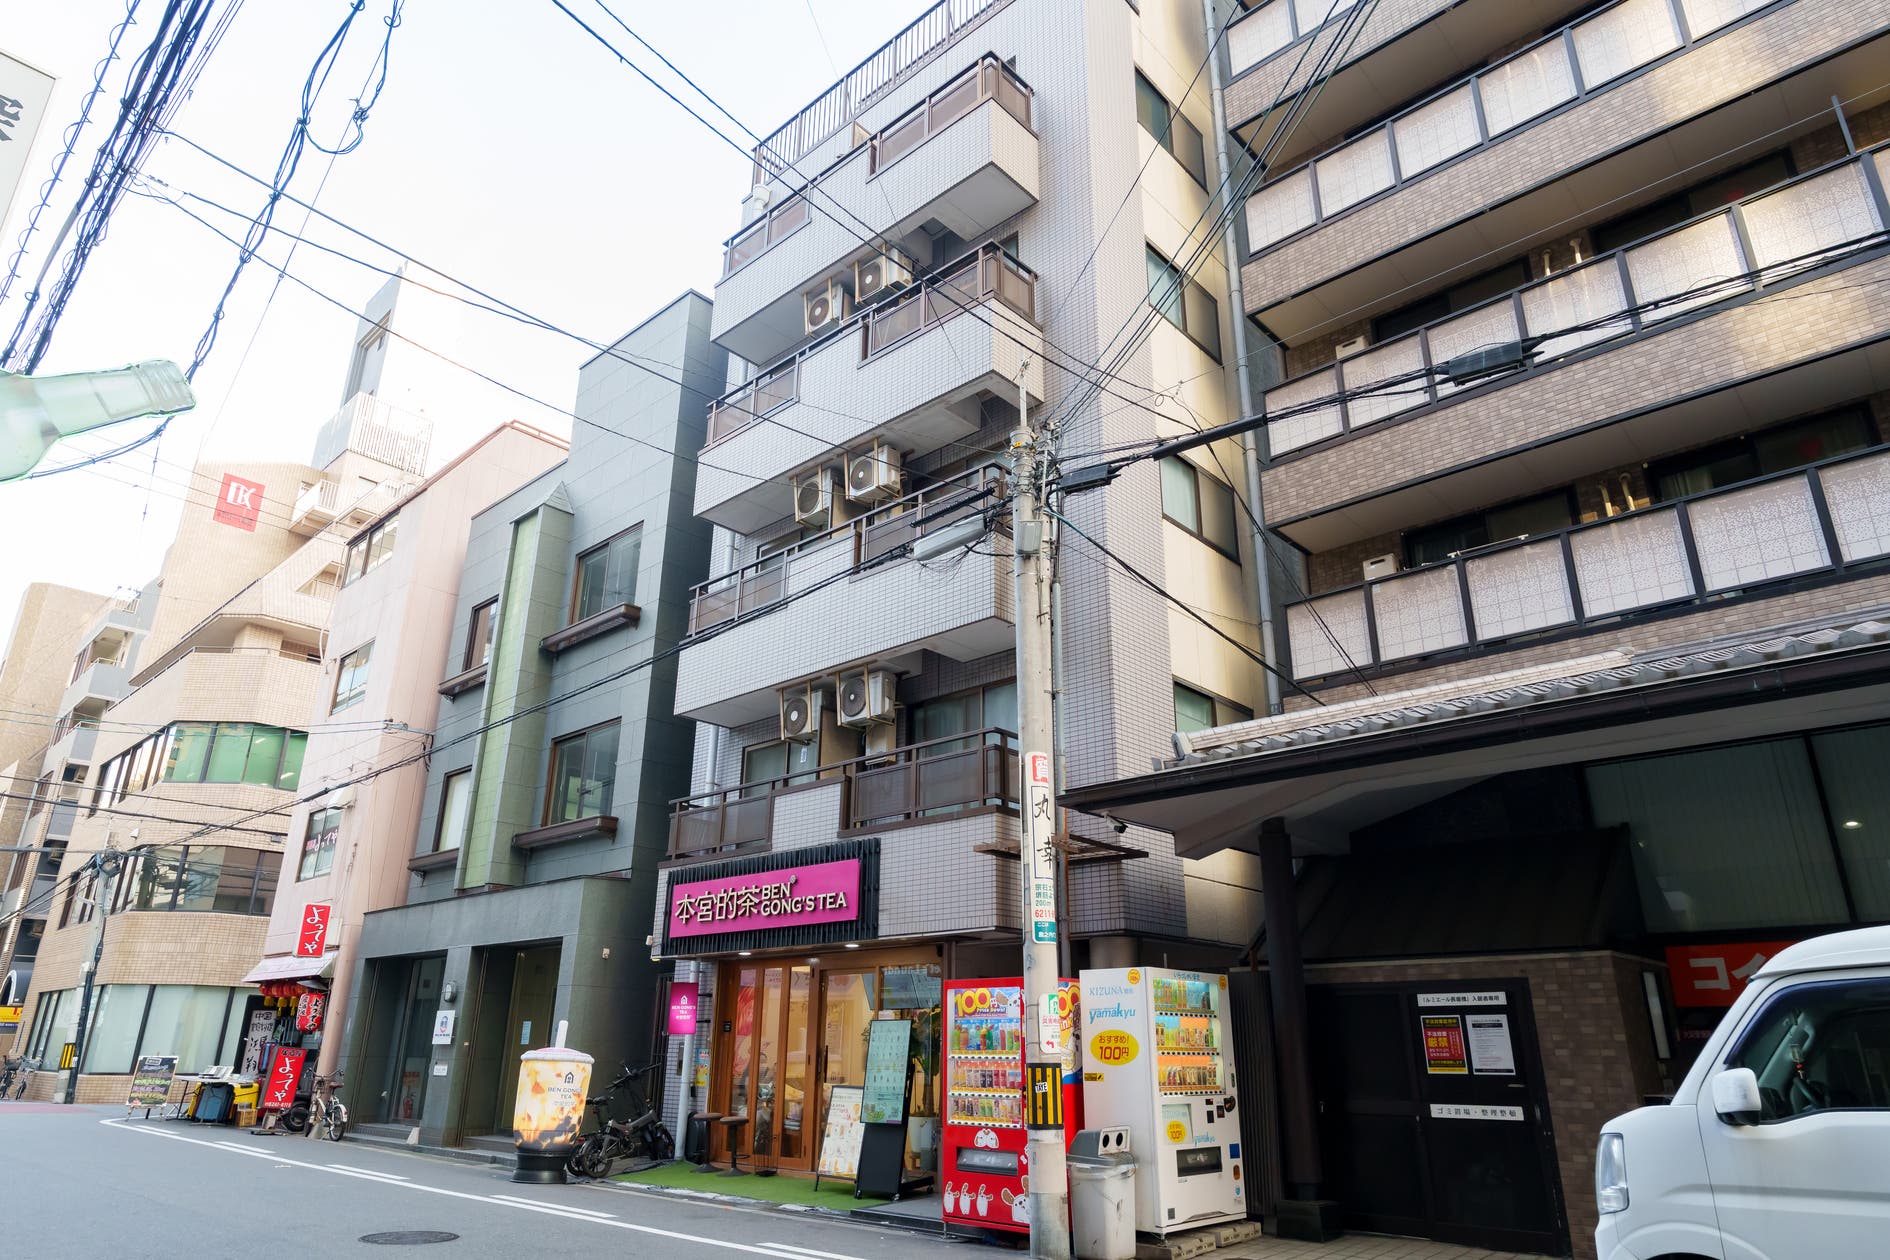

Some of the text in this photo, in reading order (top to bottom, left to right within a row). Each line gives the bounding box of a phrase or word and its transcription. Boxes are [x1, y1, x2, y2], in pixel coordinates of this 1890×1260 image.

[761, 882, 791, 900] BEN
[674, 885, 760, 924] 本宮的茶
[760, 892, 848, 917] GONG'S TEA
[304, 906, 325, 954] よってや
[1089, 987, 1123, 996] KIZUNA
[1089, 1003, 1136, 1024] yamakyu
[1099, 1046, 1130, 1060] 100円
[274, 1057, 295, 1102] よってや
